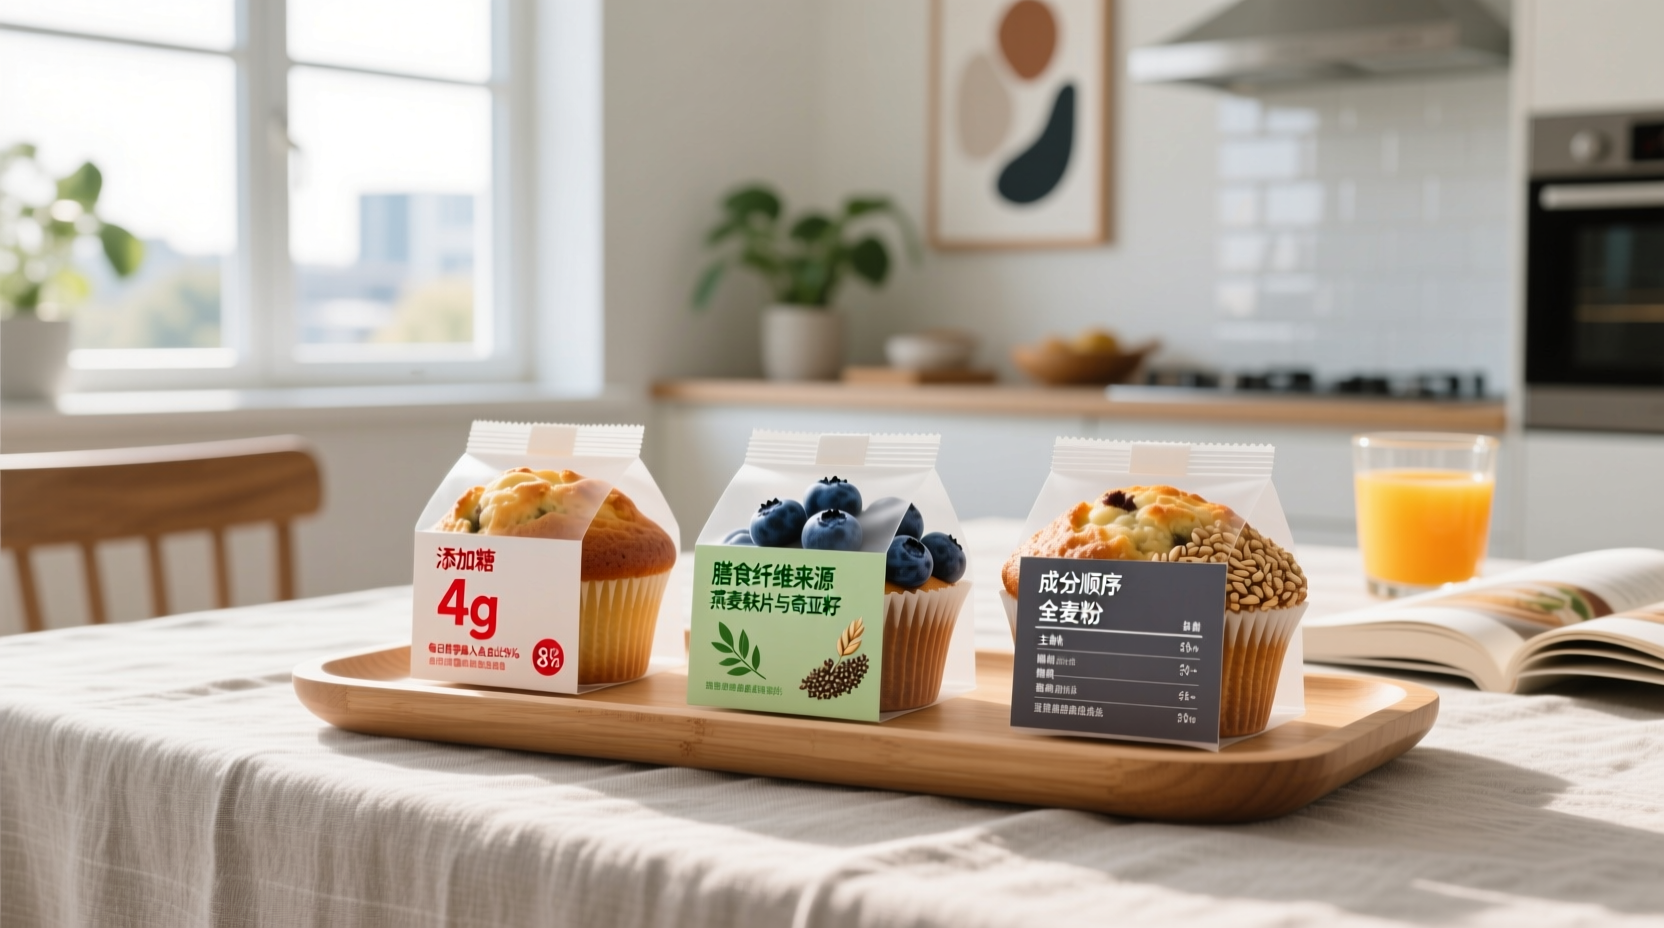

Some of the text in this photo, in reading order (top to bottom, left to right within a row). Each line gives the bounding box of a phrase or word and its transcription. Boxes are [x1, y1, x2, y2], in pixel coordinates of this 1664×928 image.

[436, 547, 496, 572] 添加糖
[711, 560, 836, 591] 膳食纤维来源
[1038, 569, 1123, 596] 成分顺序
[437, 578, 498, 640] 4g
[1038, 599, 1104, 625] 全麦粉
